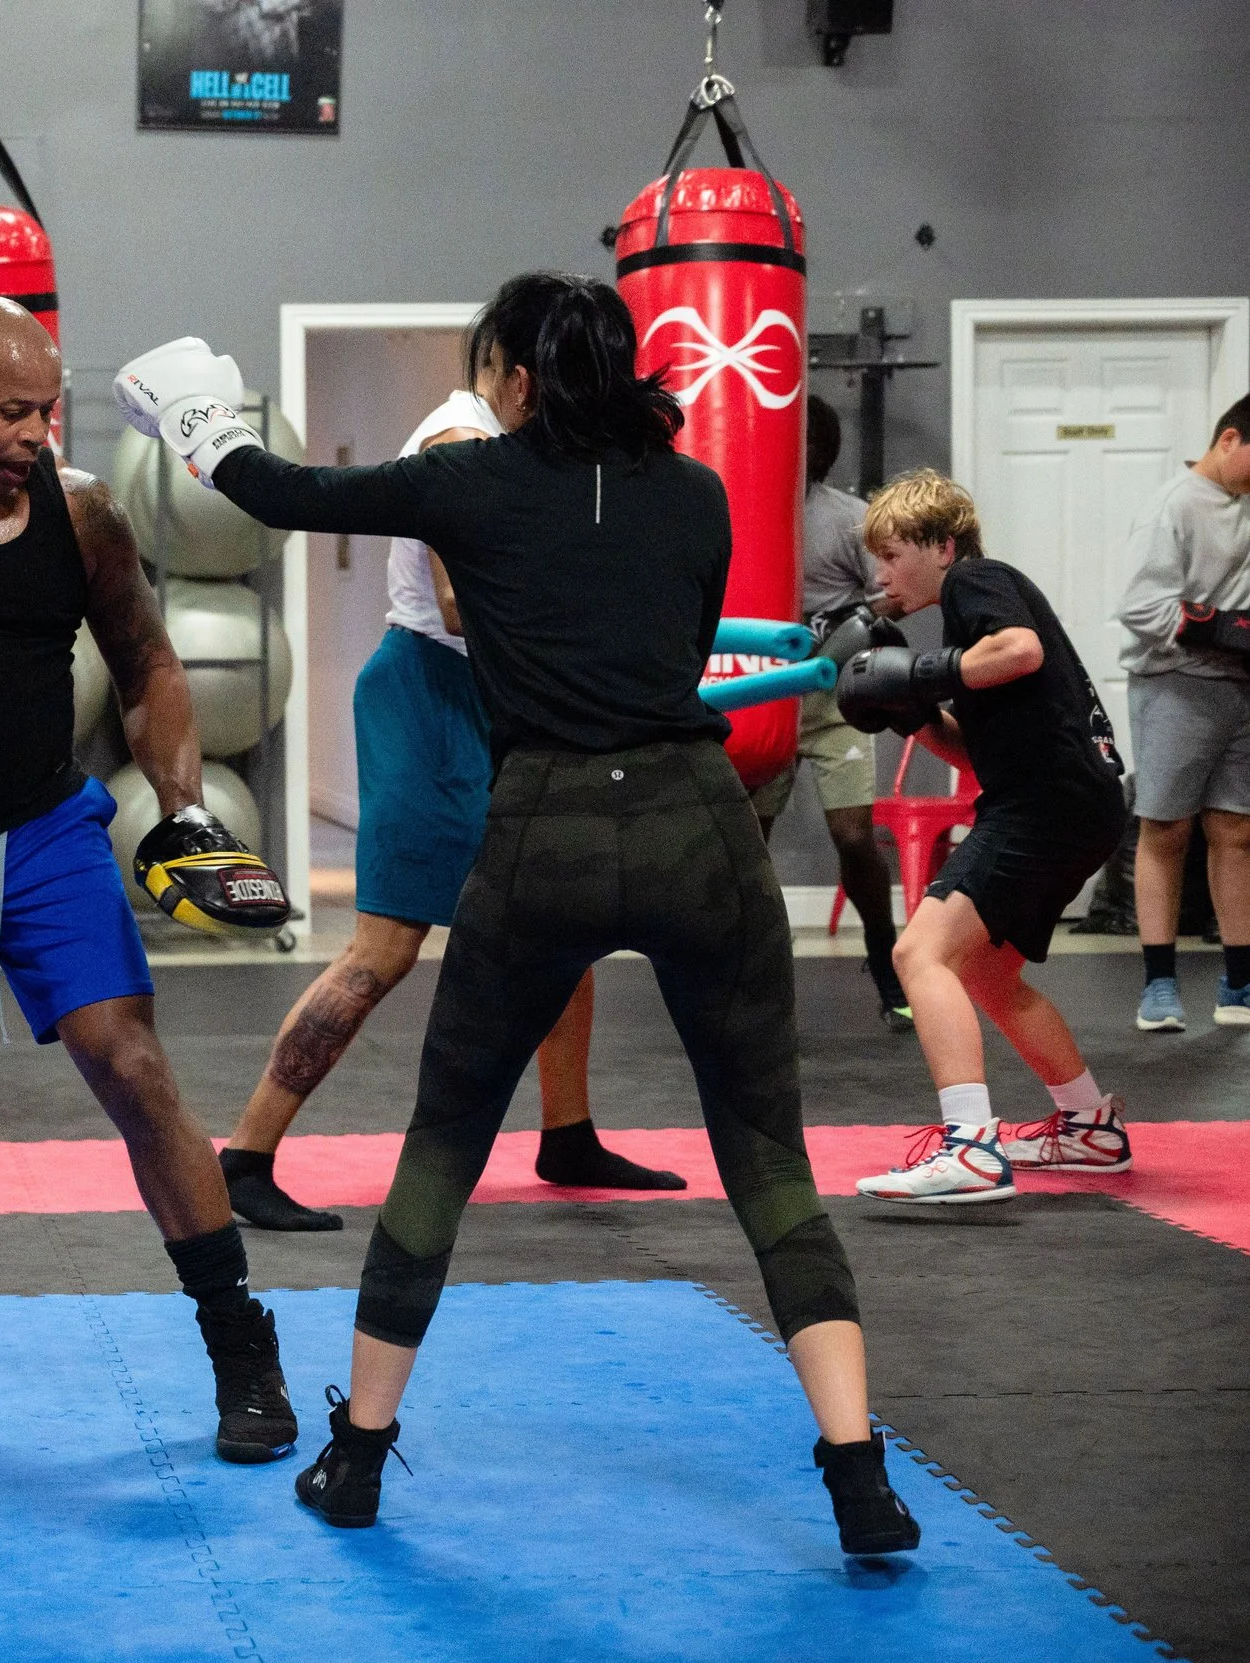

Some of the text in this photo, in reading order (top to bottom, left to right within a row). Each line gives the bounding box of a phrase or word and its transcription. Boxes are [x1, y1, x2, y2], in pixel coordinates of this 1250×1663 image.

[190, 71, 229, 100] HELL
[251, 73, 291, 102] CELL
[127, 374, 158, 406] RIVAL
